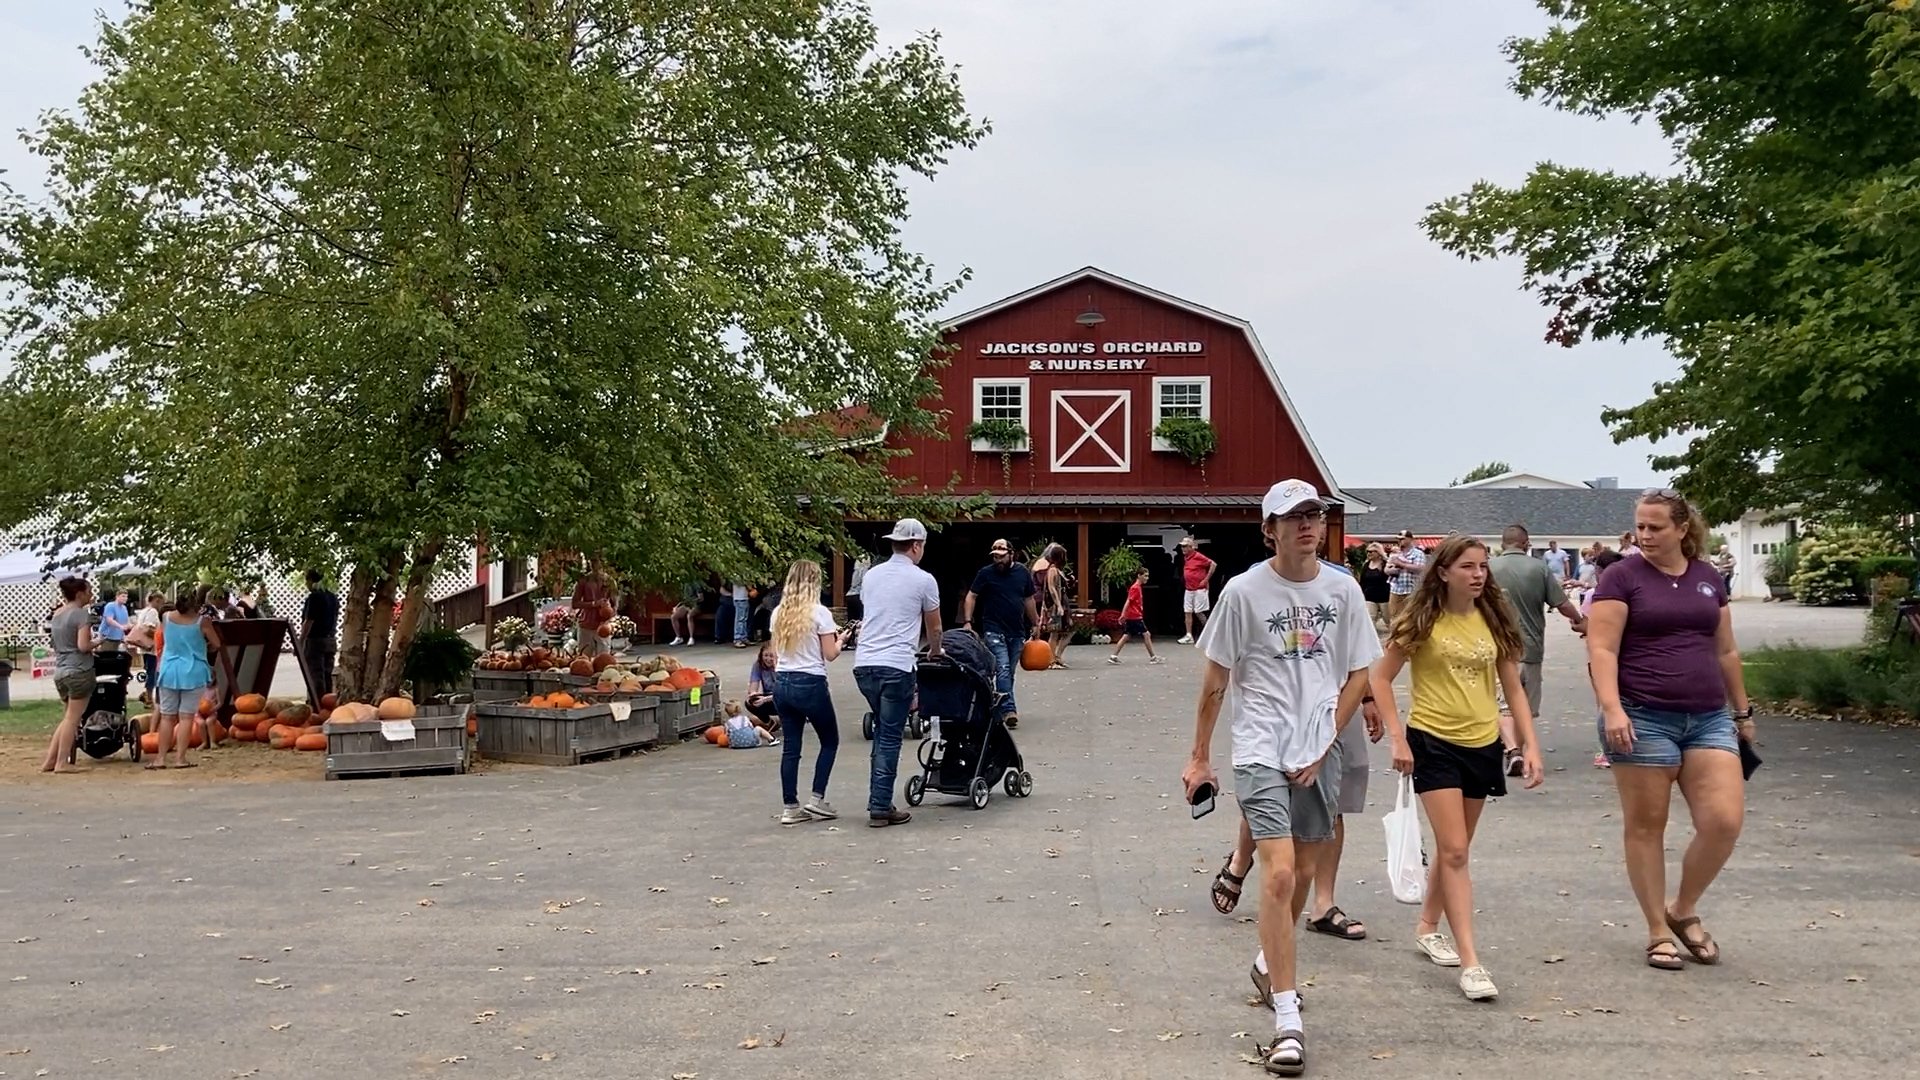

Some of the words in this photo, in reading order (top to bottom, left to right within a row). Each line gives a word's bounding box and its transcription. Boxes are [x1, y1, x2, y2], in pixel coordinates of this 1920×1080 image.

[980, 342, 1096, 354] JACKSON'S
[1102, 341, 1203, 353] ORCHARD
[1029, 359, 1044, 370] &
[1047, 359, 1147, 370] NURSERY
